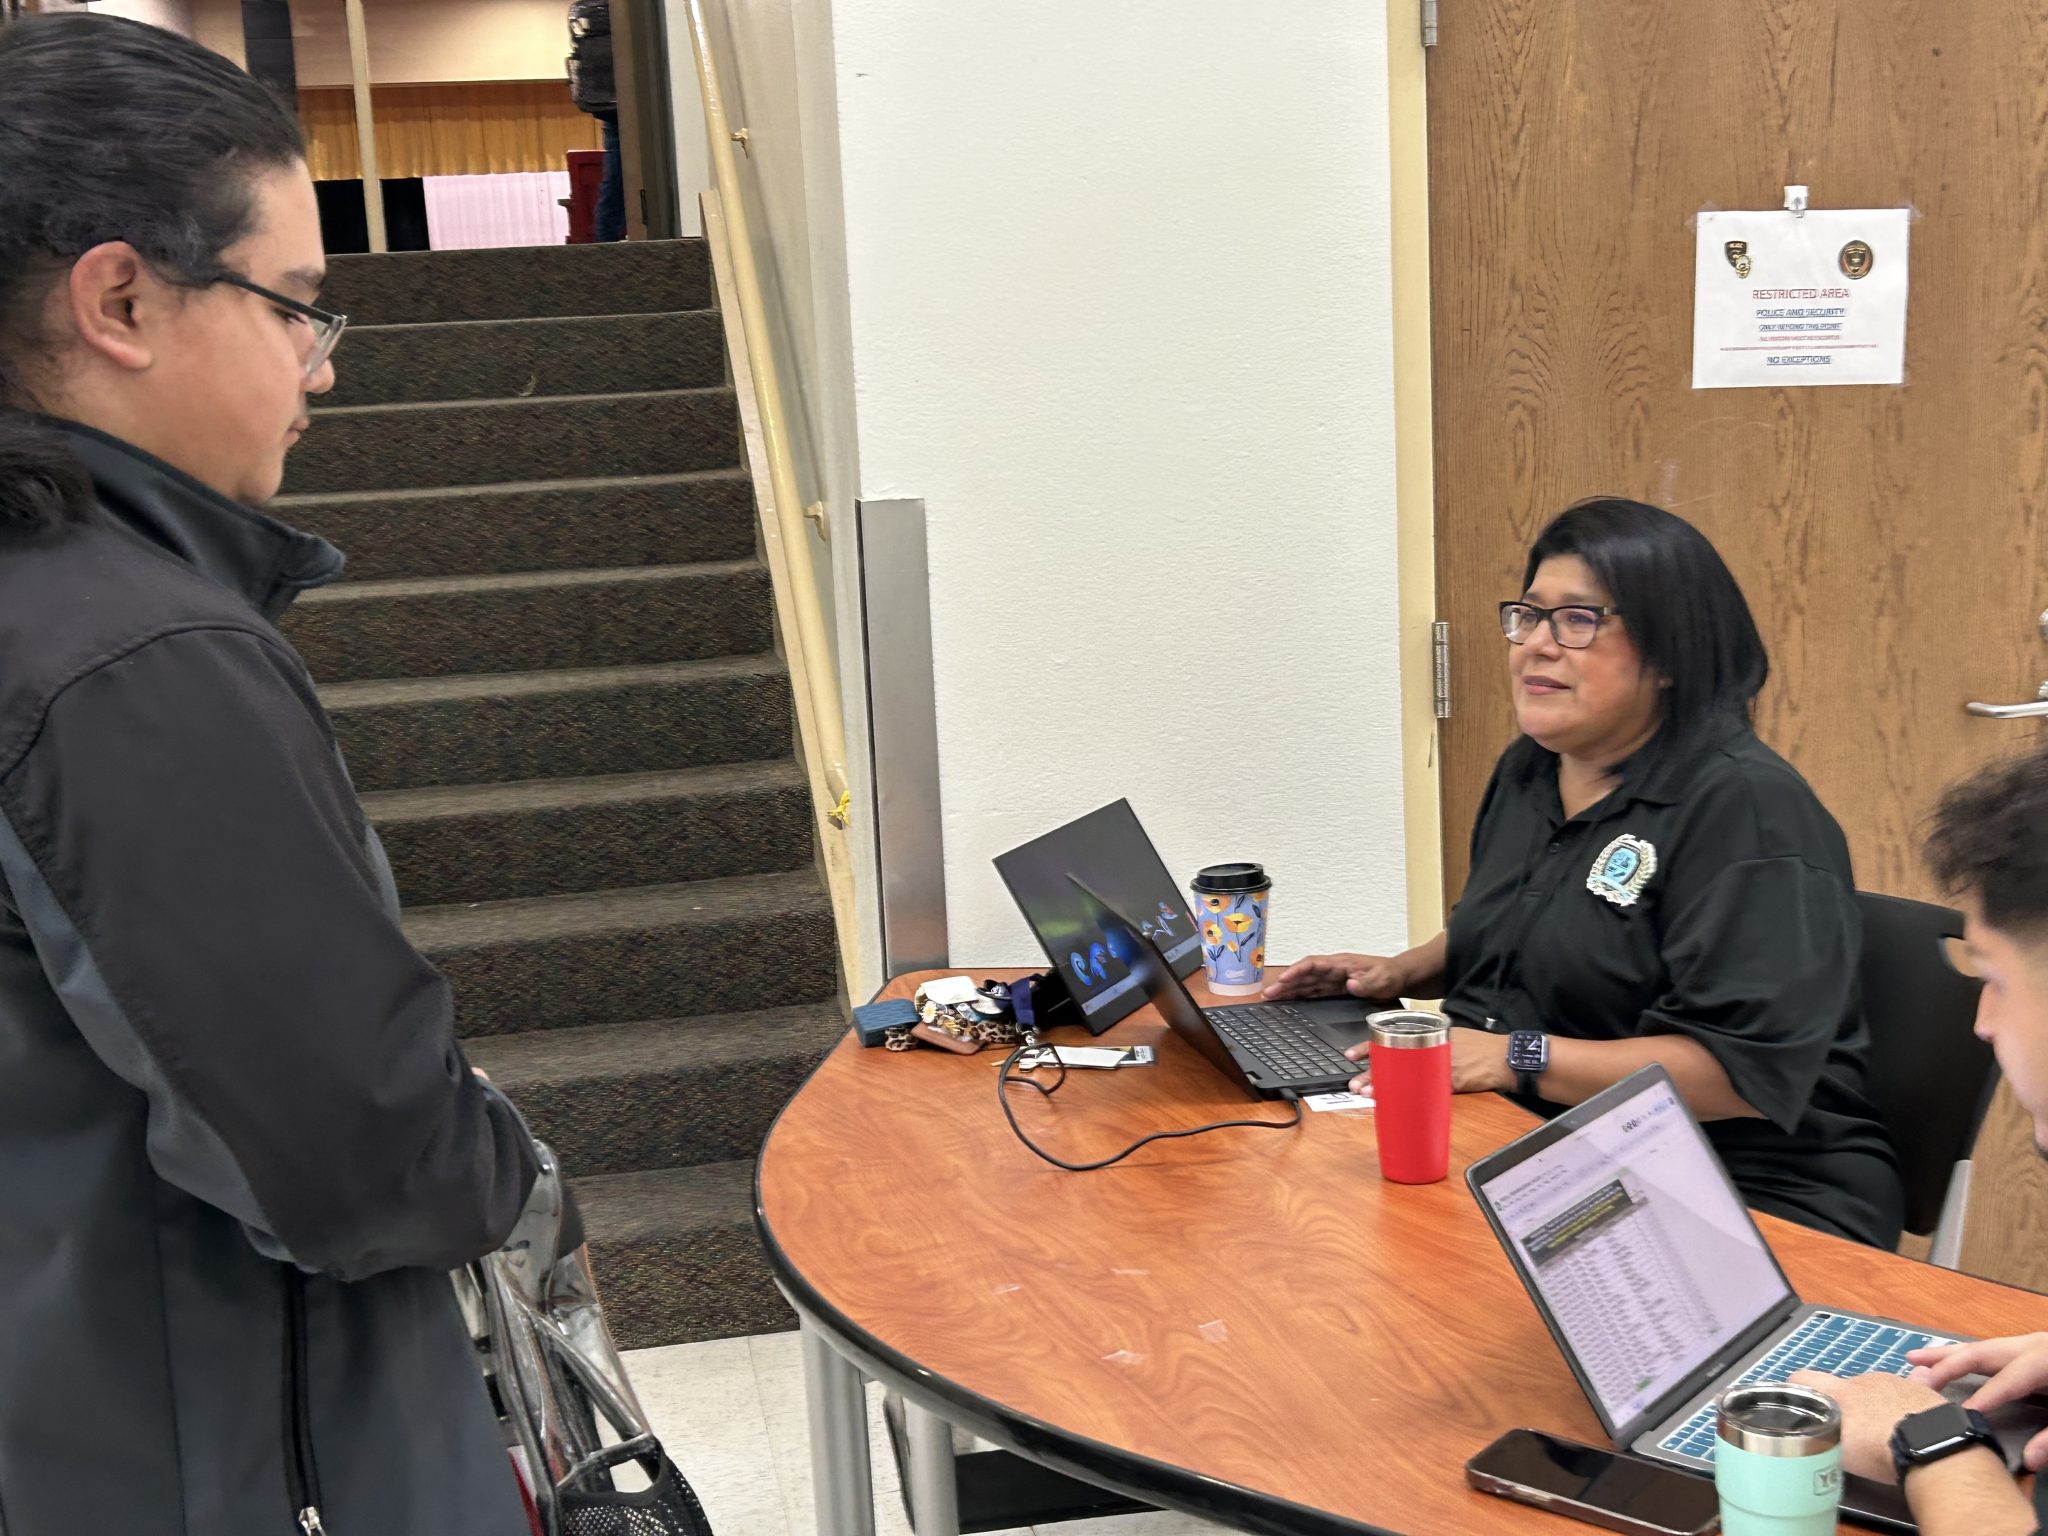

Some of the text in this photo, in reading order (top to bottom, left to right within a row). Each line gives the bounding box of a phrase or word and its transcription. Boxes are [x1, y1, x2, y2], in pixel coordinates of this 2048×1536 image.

[1752, 288, 1850, 300] RESTRICTED AREA
[1756, 308, 1845, 317] POLICE AND SECURITY
[1781, 355, 1831, 364] EXCEPTIONS
